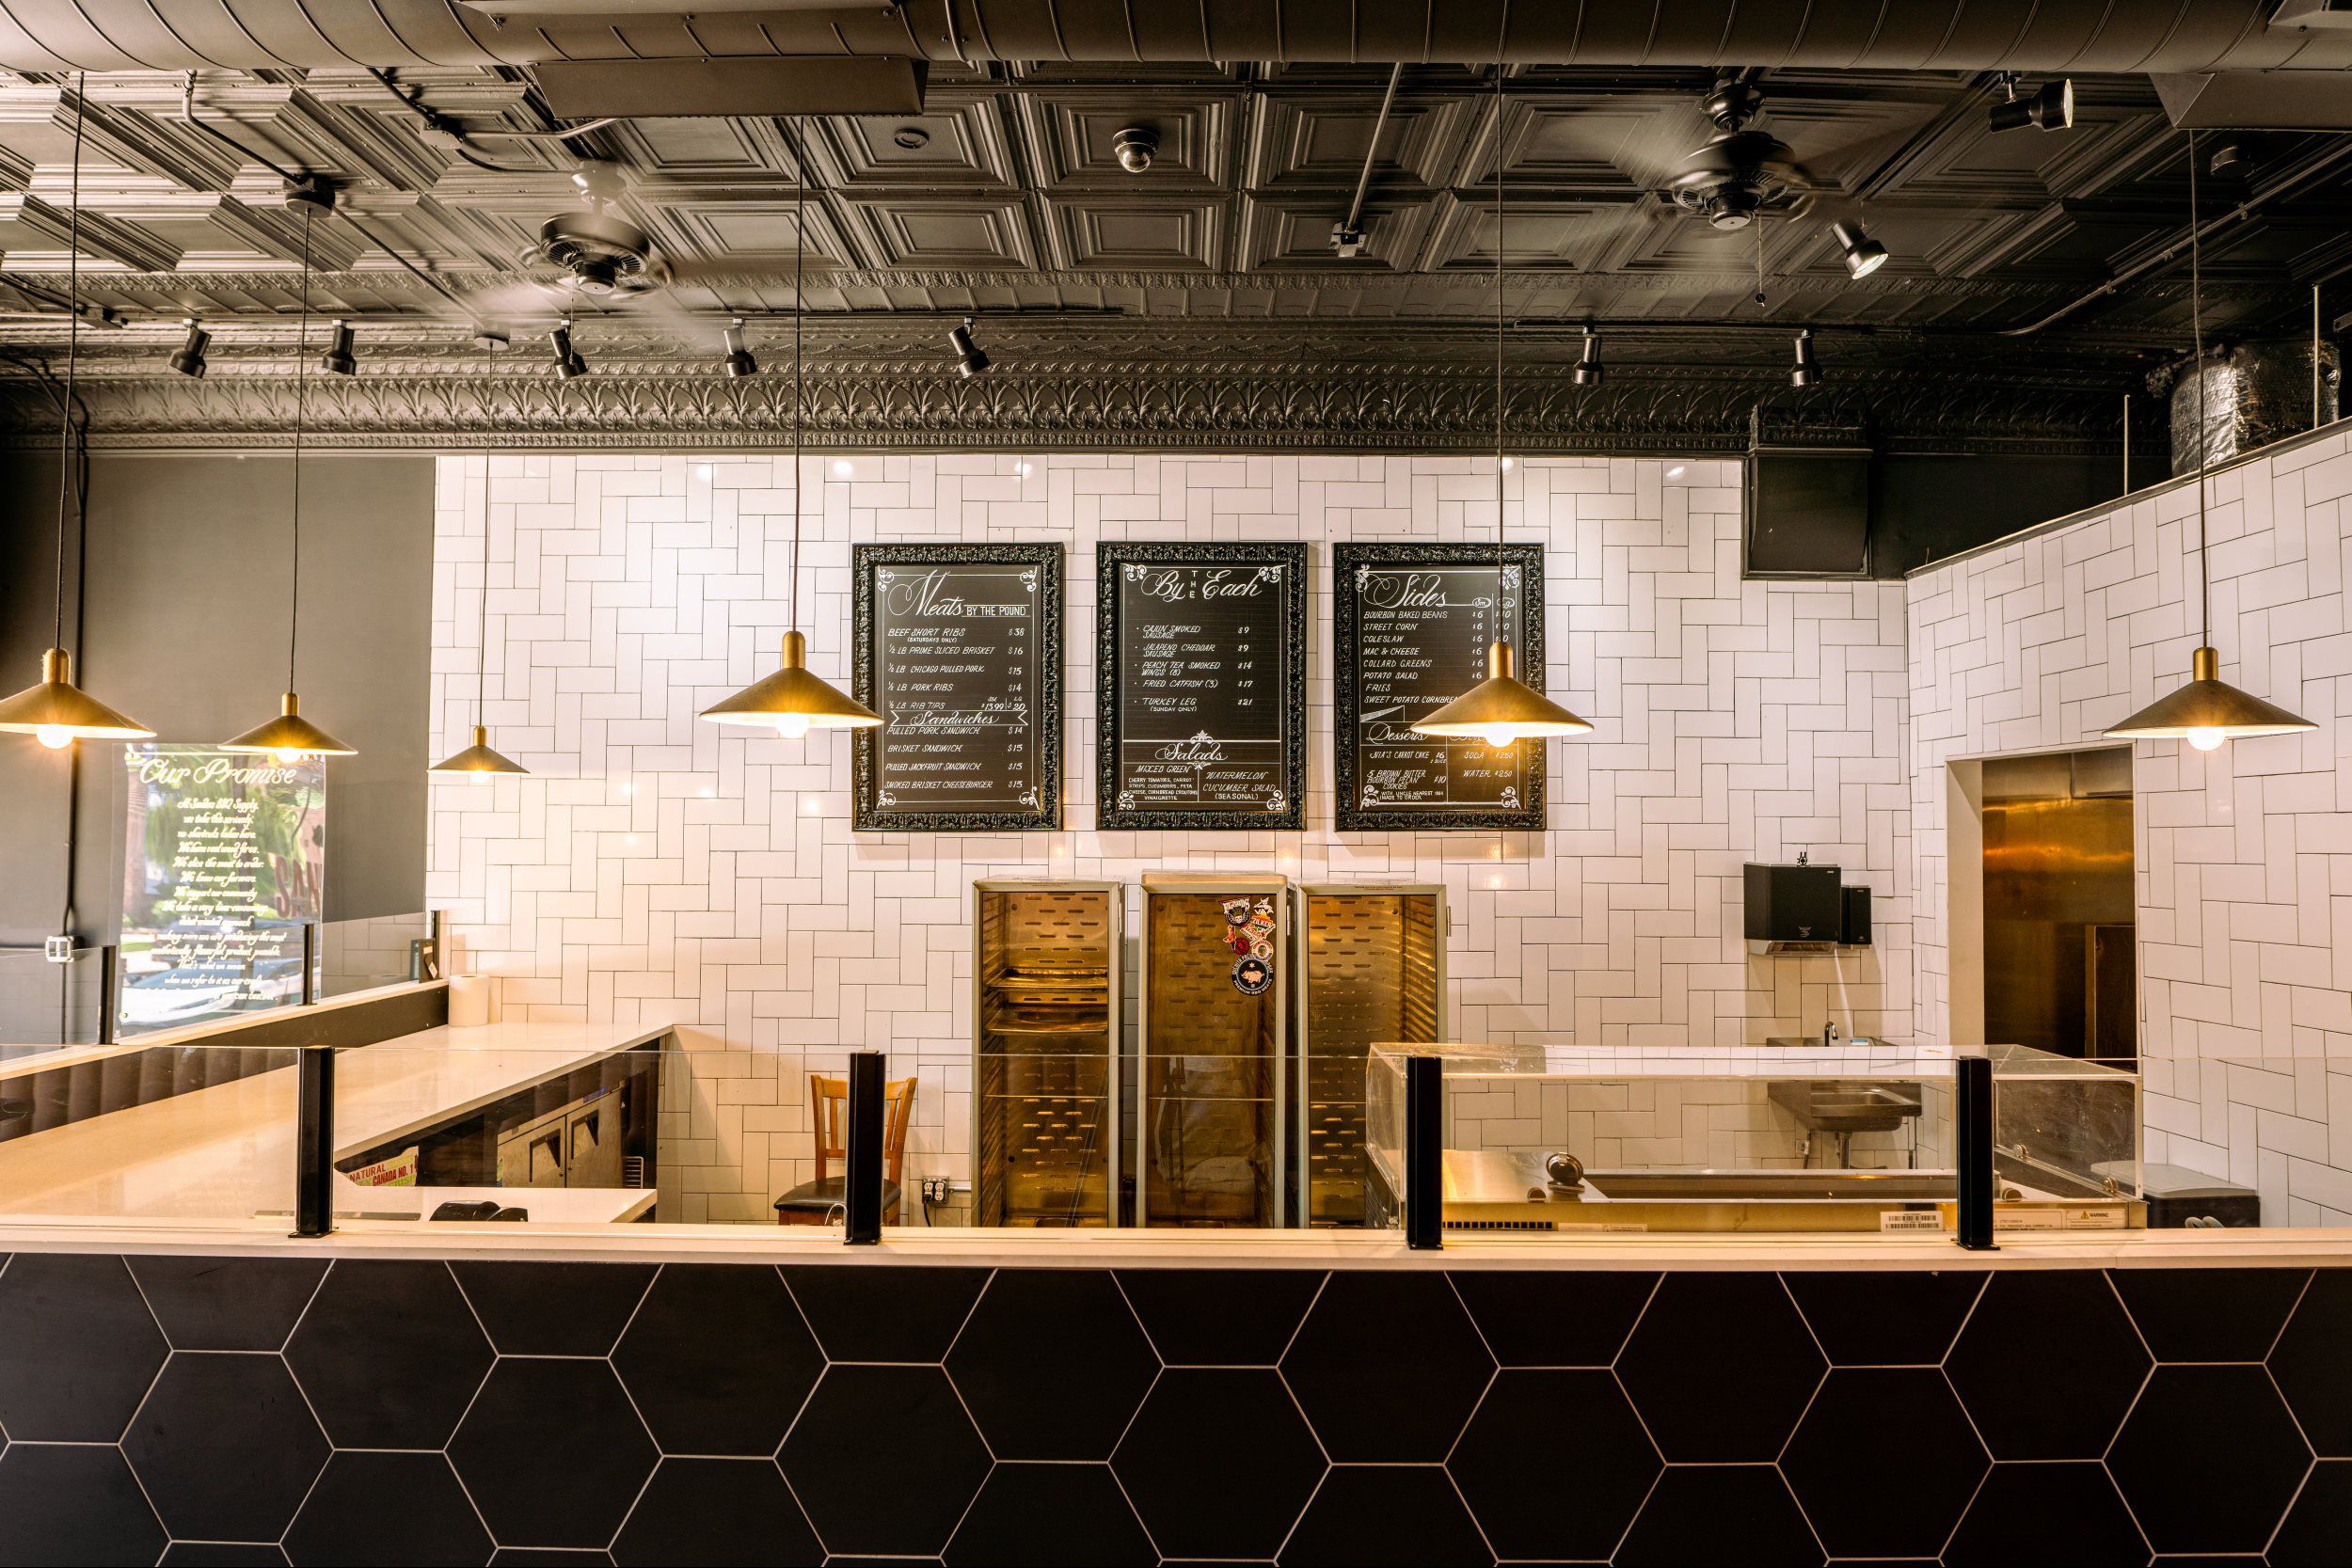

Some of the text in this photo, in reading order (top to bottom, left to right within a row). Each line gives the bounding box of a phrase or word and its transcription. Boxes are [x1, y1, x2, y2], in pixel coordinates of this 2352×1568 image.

[888, 569, 1026, 616] Meats BY THE POUND
[1141, 570, 1262, 602] By Each
[1364, 574, 1446, 608] Sides
[888, 628, 910, 637] BEEF
[910, 628, 939, 637] SHORT
[942, 628, 965, 637] RIBS
[910, 665, 938, 673] CHICAGO
[910, 710, 1000, 725] Sandwiches
[1155, 743, 1228, 761] Salads
[140, 758, 297, 784] Our Promise
[1206, 772, 1268, 780] WATERMELON
[350, 1163, 386, 1182] NATURAL
[373, 1169, 397, 1186] CANADA
[398, 1165, 408, 1178] NO.
